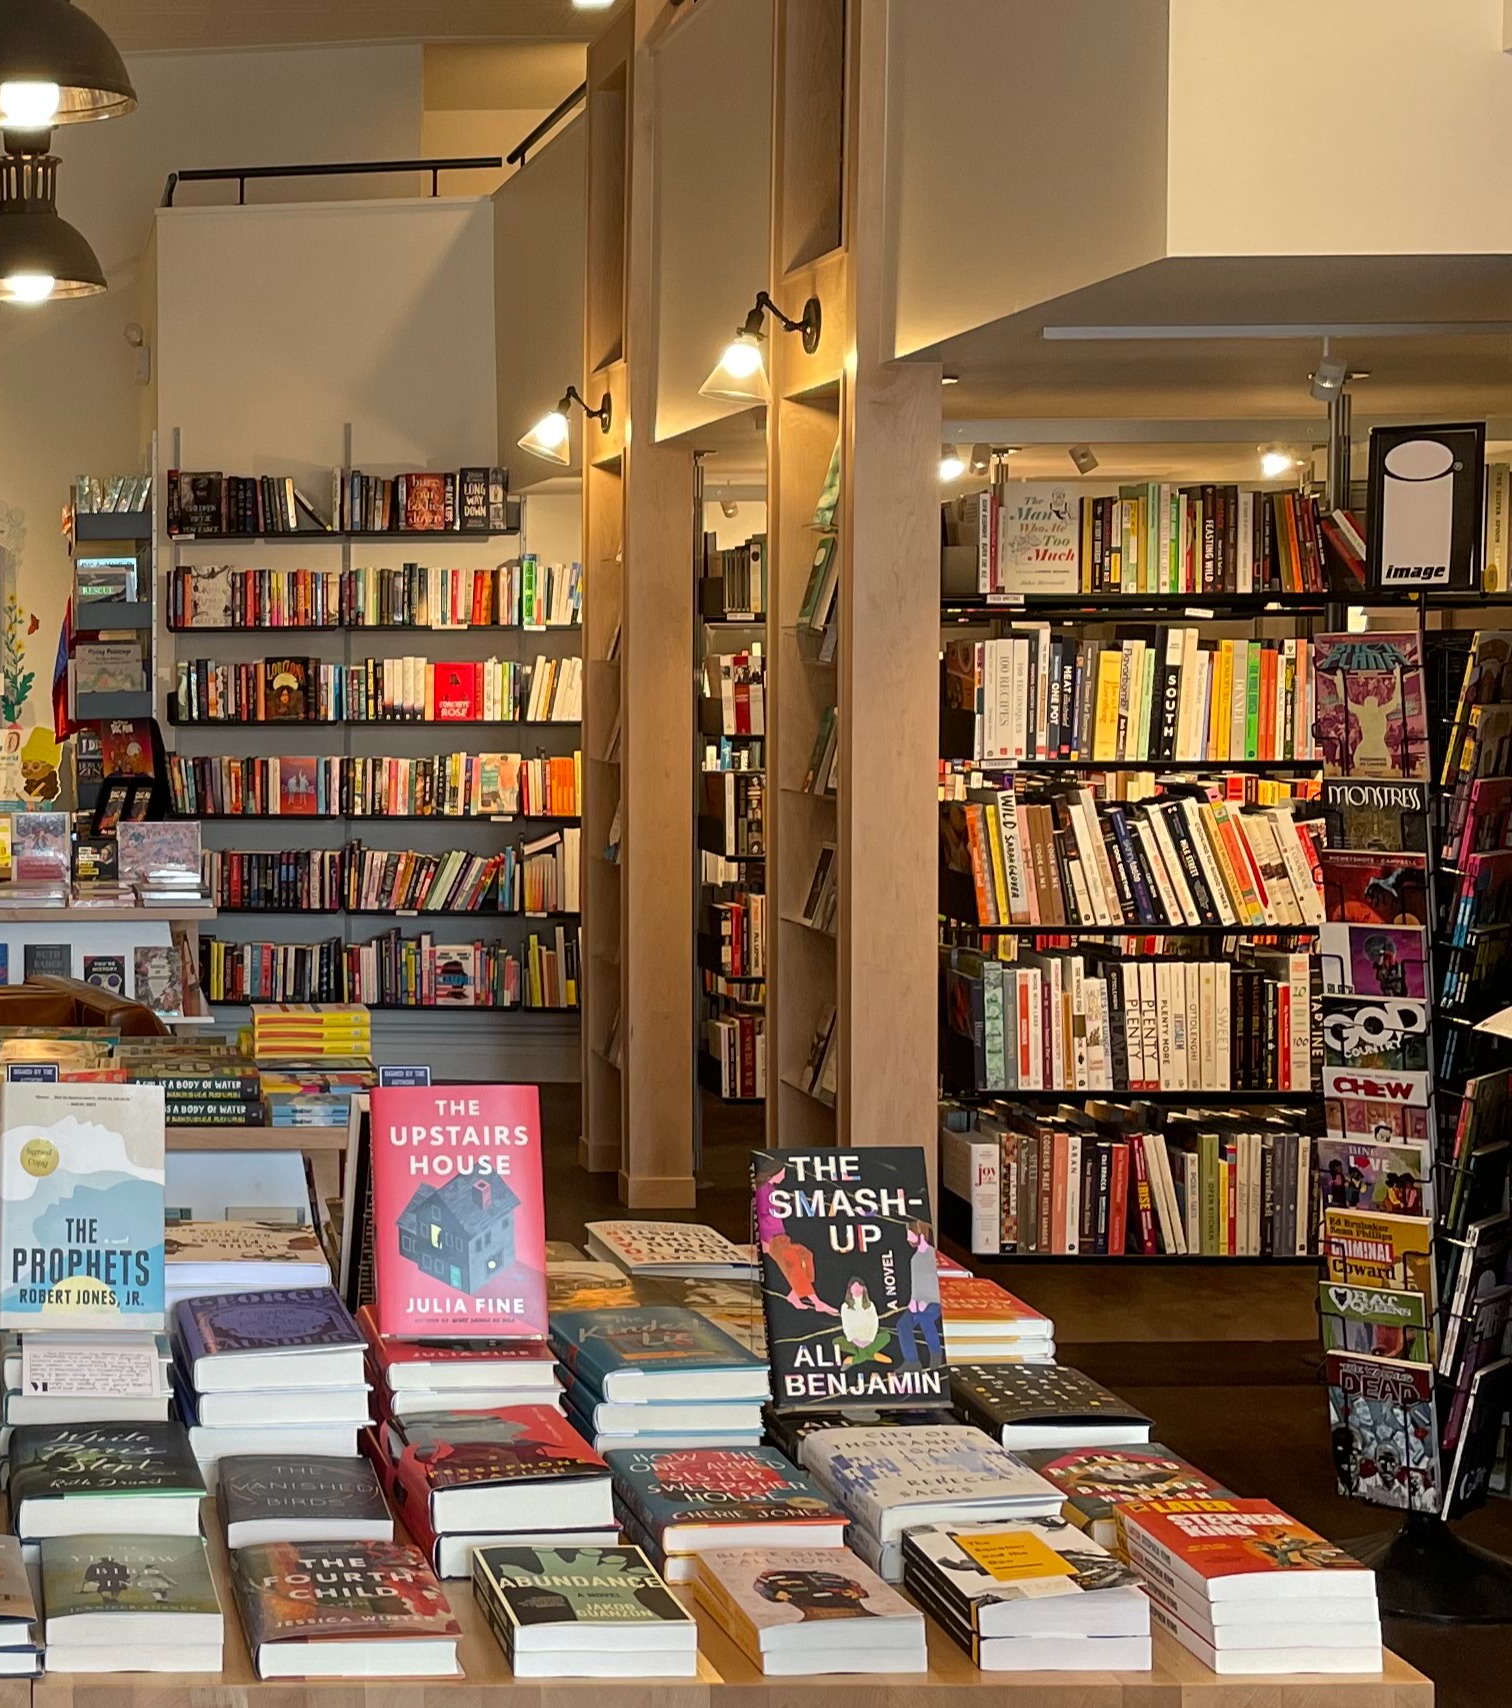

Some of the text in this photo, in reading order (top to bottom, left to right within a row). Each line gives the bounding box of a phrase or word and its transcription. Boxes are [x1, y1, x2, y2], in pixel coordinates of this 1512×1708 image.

[412, 476, 439, 487] burn
[463, 483, 486, 496] LONG
[407, 500, 444, 511] bodies
[466, 495, 483, 506] WAY
[1024, 497, 1043, 505] The
[464, 506, 487, 518] DOWN
[1009, 507, 1053, 521] Man
[1019, 523, 1044, 532] Who
[1042, 535, 1070, 546] Too
[1027, 549, 1074, 562] Much
[1204, 519, 1214, 582] FEASTING WILD
[1385, 564, 1445, 580] image
[82, 586, 114, 595] RESCUE
[1062, 665, 1072, 693] HEAT
[1000, 656, 1010, 728] 100 RECIPES
[1049, 683, 1059, 725] ONE POT
[1163, 674, 1176, 737] SOUTH
[441, 708, 468, 718] ROSE
[1328, 785, 1421, 811] MONSTRESS
[1001, 795, 1019, 899] WILD SARAH GLOVER
[1195, 823, 1228, 909] COOKING GOOD TIMES
[1293, 986, 1307, 997] 20
[1161, 1000, 1169, 1036] PLENTY
[1127, 1000, 1142, 1060] PLENTY
[1143, 1001, 1157, 1060] PLENTY
[1189, 1003, 1197, 1062] OTTOLENGHI
[1217, 1007, 1228, 1053] SWEET
[1293, 1037, 1309, 1046] 100
[178, 1080, 241, 1090] BODY OF WATER
[1333, 1076, 1414, 1100] CHEW
[181, 1104, 246, 1115] BODY OF WATER
[435, 1100, 480, 1116] THE
[390, 1126, 529, 1146] UPSTAIRS
[410, 1155, 511, 1175] HOUSE
[1042, 1135, 1051, 1191] COOKING MEAT
[1070, 1145, 1078, 1174] ARAN
[790, 1156, 860, 1182] THE
[769, 1188, 923, 1219] SMASH-
[65, 1218, 98, 1244] THE
[1329, 1217, 1390, 1232] Ed Brubaker
[830, 1224, 882, 1253] UP
[1329, 1226, 1393, 1241] Sean Phillips
[13, 1248, 150, 1286] PROPHETS
[883, 1250, 897, 1297] NOVEL
[19, 1289, 144, 1306] ROBERT JONES, JR.
[1355, 1287, 1400, 1306] RAT
[406, 1297, 525, 1314] JULIA FINE
[1349, 1301, 1412, 1317] QUEENS
[793, 1345, 841, 1367] ALI
[784, 1371, 942, 1396] BENJAMIN
[48, 1430, 150, 1444] While
[834, 1438, 957, 1450] THOUSAND
[633, 1451, 763, 1463] HOW THE
[58, 1457, 165, 1474] Slept
[272, 1465, 318, 1476] THE
[669, 1470, 766, 1481] SISTER
[907, 1475, 1013, 1486] REBECCA
[231, 1481, 373, 1493] VANISHED
[648, 1480, 807, 1494] SWEEPS HER
[900, 1487, 974, 1497] SACKS
[267, 1497, 346, 1508] BIRDS
[683, 1490, 789, 1503] HOUSE
[672, 1508, 830, 1520] CHERIE JONES
[1151, 1501, 1239, 1513] LATER
[1167, 1514, 1293, 1527] STEPHEN
[1183, 1524, 1257, 1537] KING
[299, 1557, 367, 1570] THE
[261, 1570, 415, 1587] FOURTH
[500, 1575, 662, 1591] ABUNDANCE
[288, 1586, 399, 1600] CHILD
[577, 1609, 653, 1618] GUANZON
[584, 1602, 636, 1612] JAKOB
[274, 1614, 436, 1629] JESSICA WINTER
